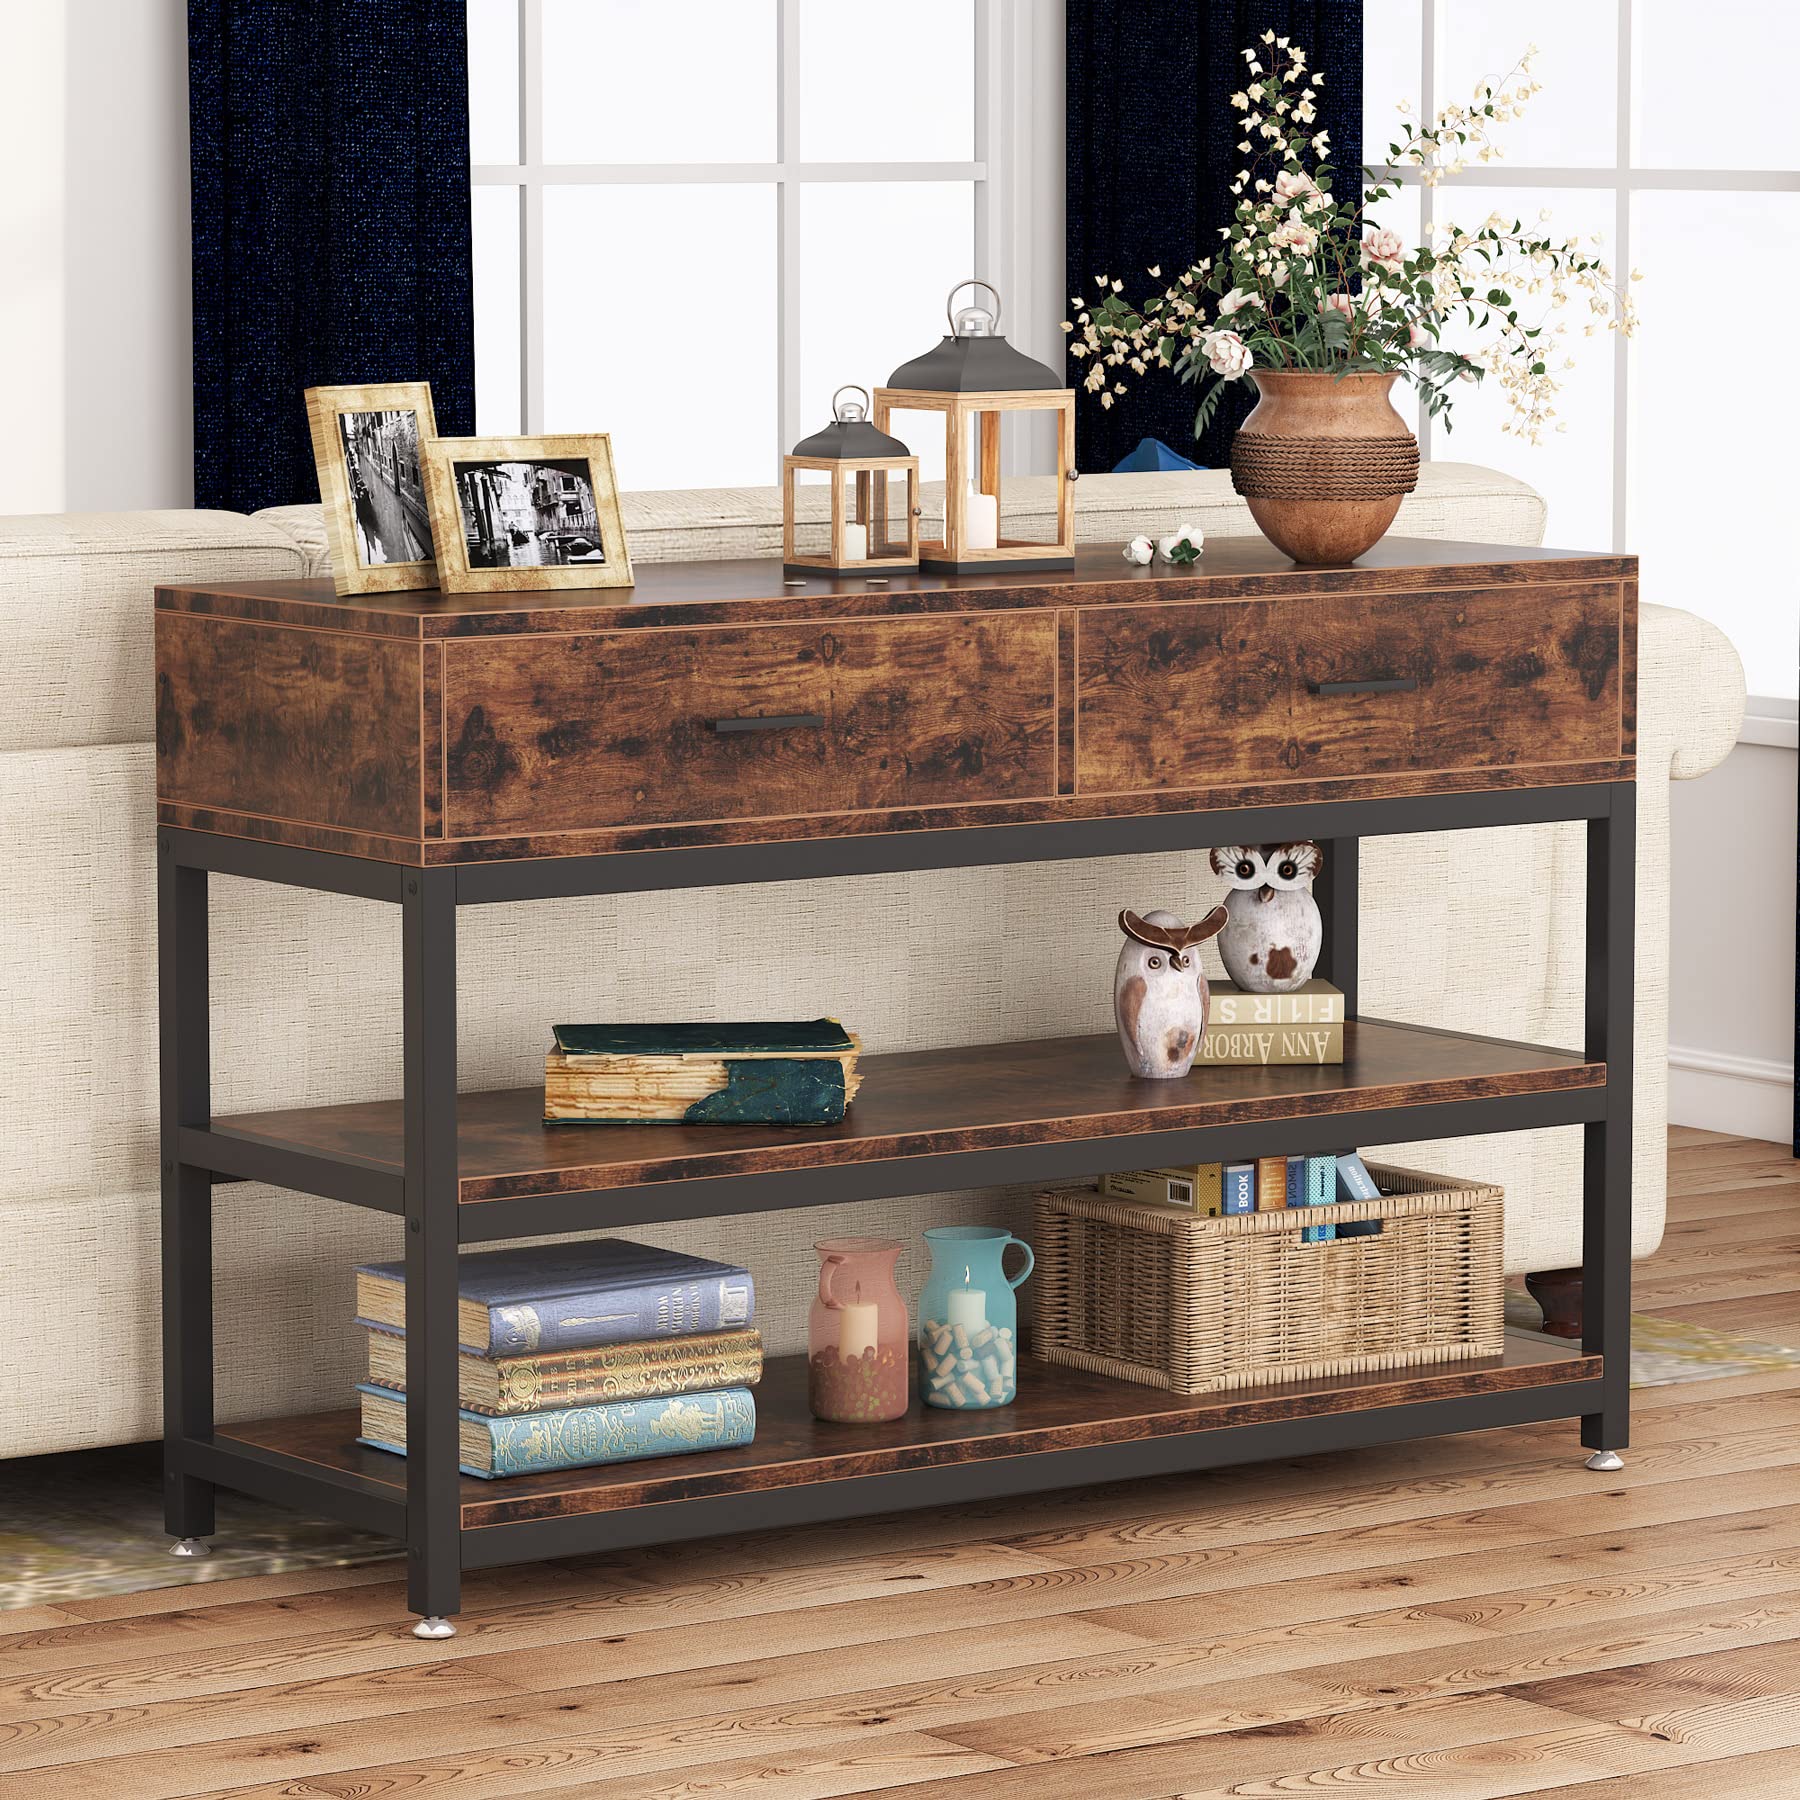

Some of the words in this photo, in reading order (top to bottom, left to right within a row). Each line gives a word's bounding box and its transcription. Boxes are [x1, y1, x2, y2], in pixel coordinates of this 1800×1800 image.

[1281, 1031, 1331, 1064] ANN
[1238, 1174, 1249, 1208] BOOK
[656, 1295, 669, 1331] WORK
